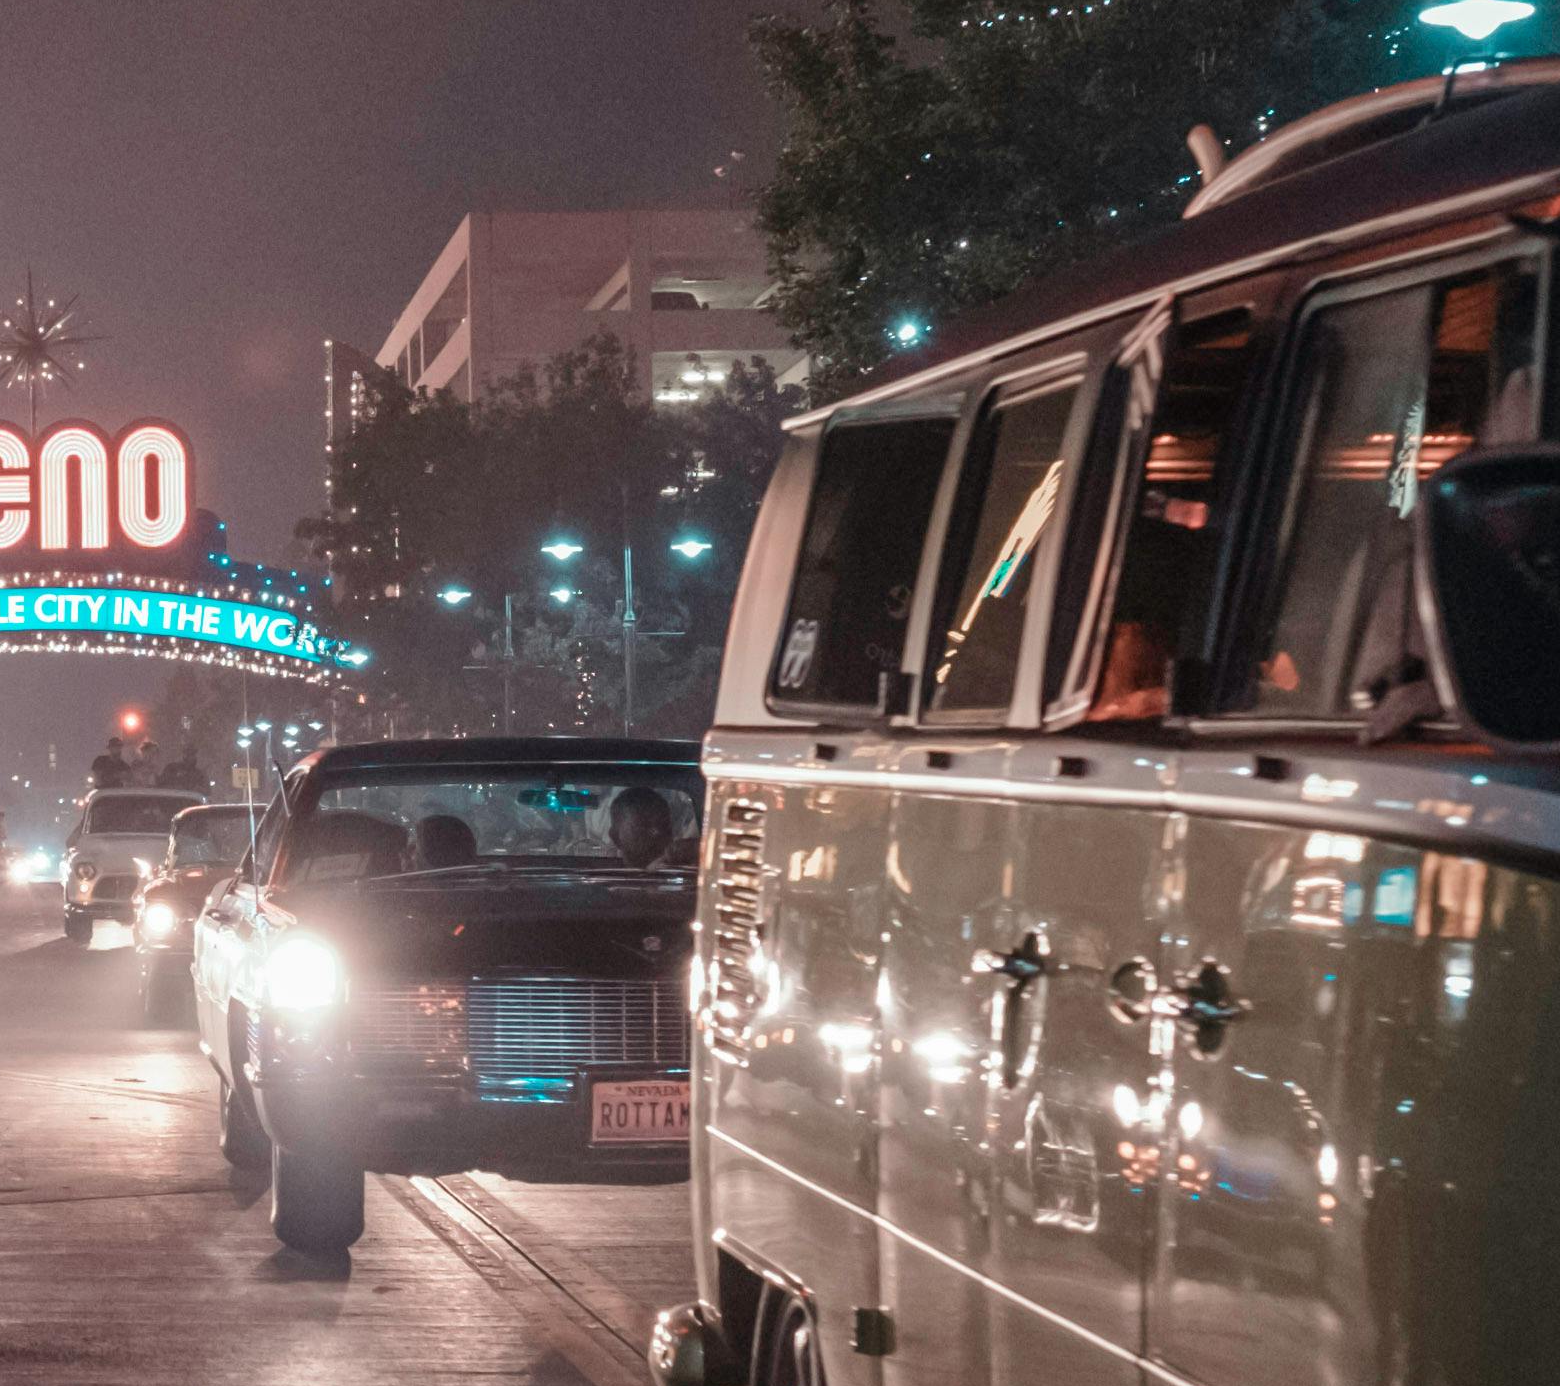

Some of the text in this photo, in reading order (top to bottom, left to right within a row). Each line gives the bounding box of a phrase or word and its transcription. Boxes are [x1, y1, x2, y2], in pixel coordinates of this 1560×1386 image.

[33, 594, 106, 625] CITY
[113, 596, 150, 627] IN
[158, 599, 221, 636] THE
[233, 609, 322, 656] WOR
[627, 1085, 682, 1097] NEVADA
